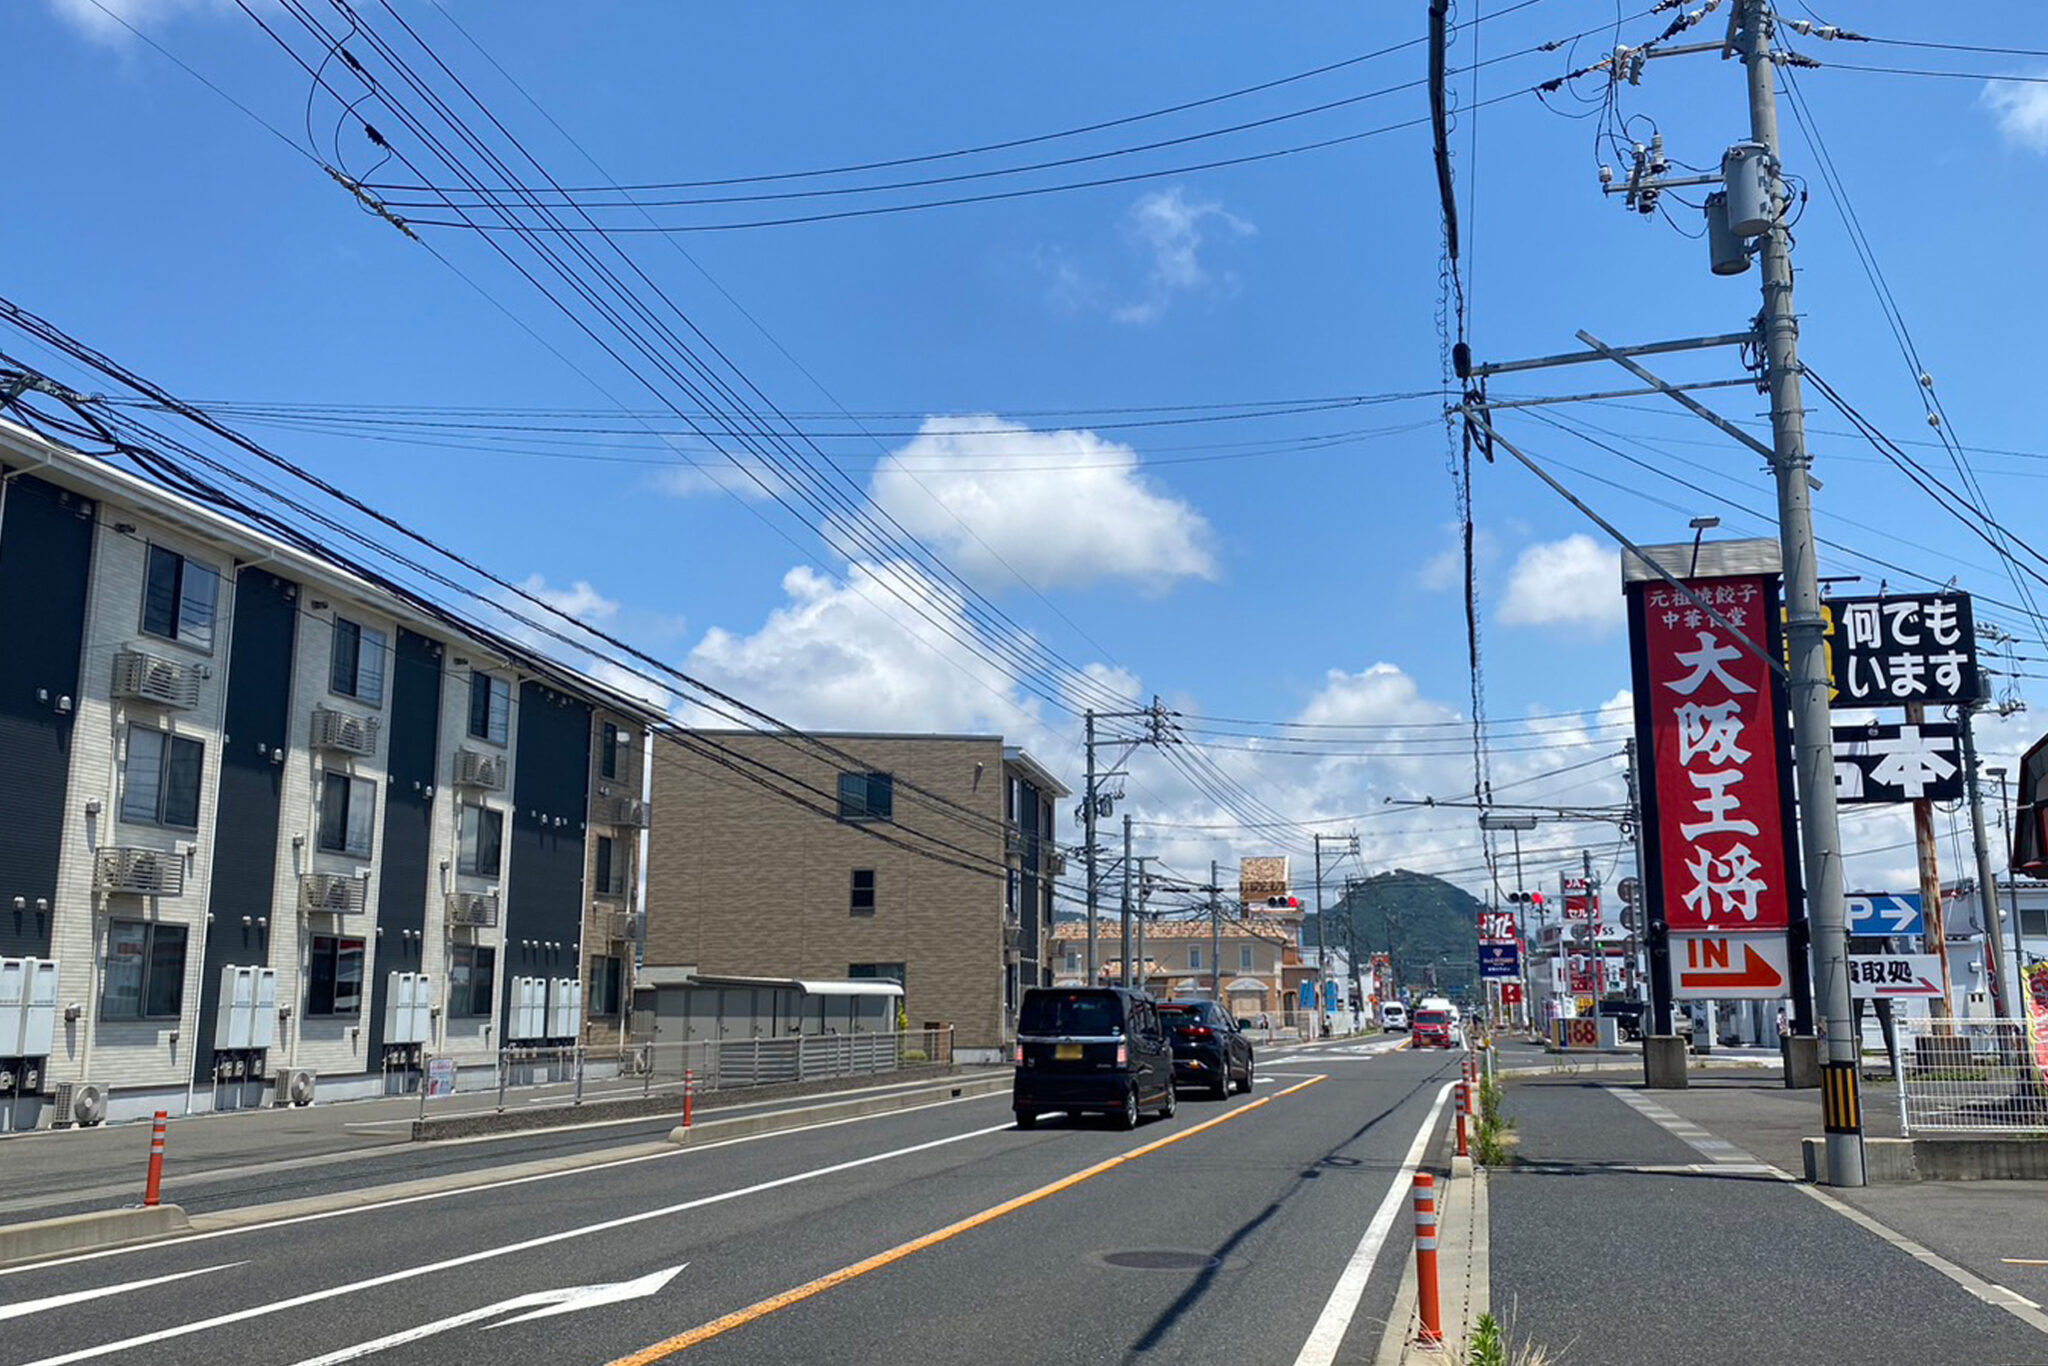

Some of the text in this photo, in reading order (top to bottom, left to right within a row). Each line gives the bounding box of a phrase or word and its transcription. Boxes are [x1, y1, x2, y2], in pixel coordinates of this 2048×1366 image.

[1842, 599, 1961, 650] 何でも
[1848, 650, 1968, 698] います
[1662, 631, 1768, 921] 大阪王将
[1845, 897, 1873, 931] P
[1688, 938, 1729, 968] IN
